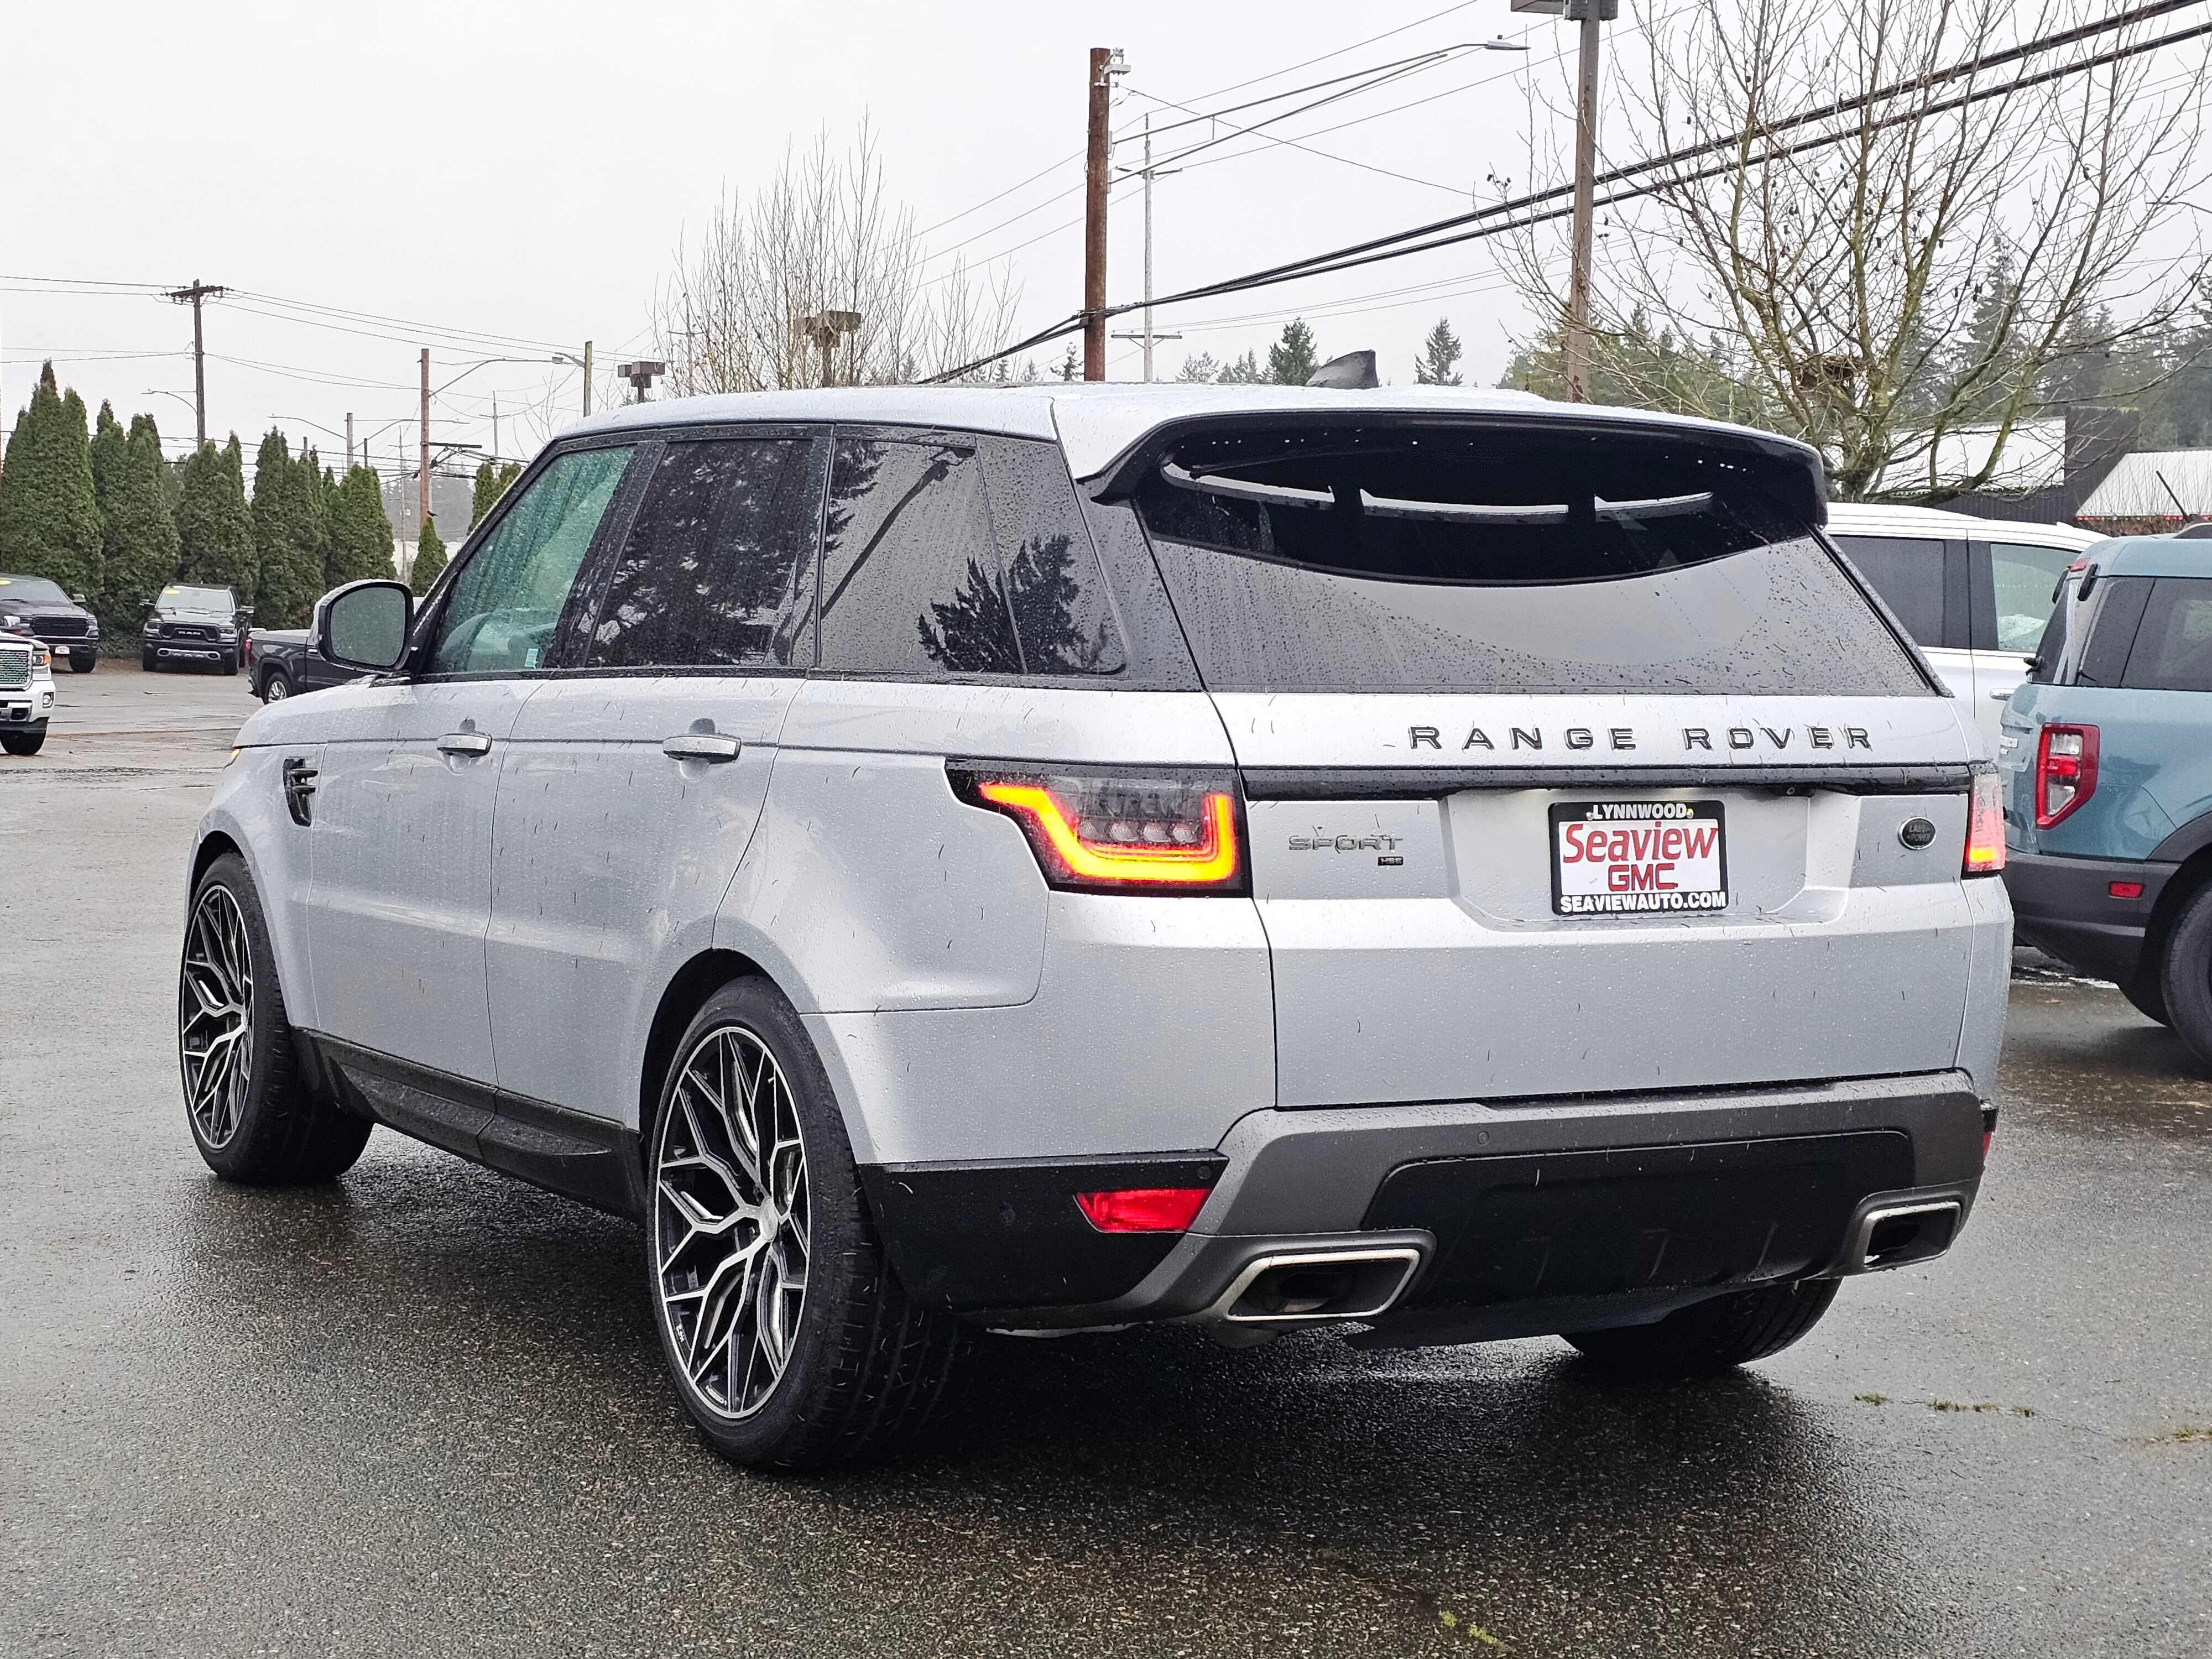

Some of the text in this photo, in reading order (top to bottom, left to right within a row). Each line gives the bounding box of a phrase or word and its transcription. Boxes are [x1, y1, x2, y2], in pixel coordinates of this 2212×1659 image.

[1408, 726, 1873, 751] RANGE ROVER
[1593, 804, 1687, 820] LYNNWOOD
[1289, 835, 1404, 851] SPORT
[1563, 821, 1719, 863] Seaview
[1608, 863, 1678, 891] GMC
[1561, 891, 1726, 913] SEAVIEWAUTO.COM
